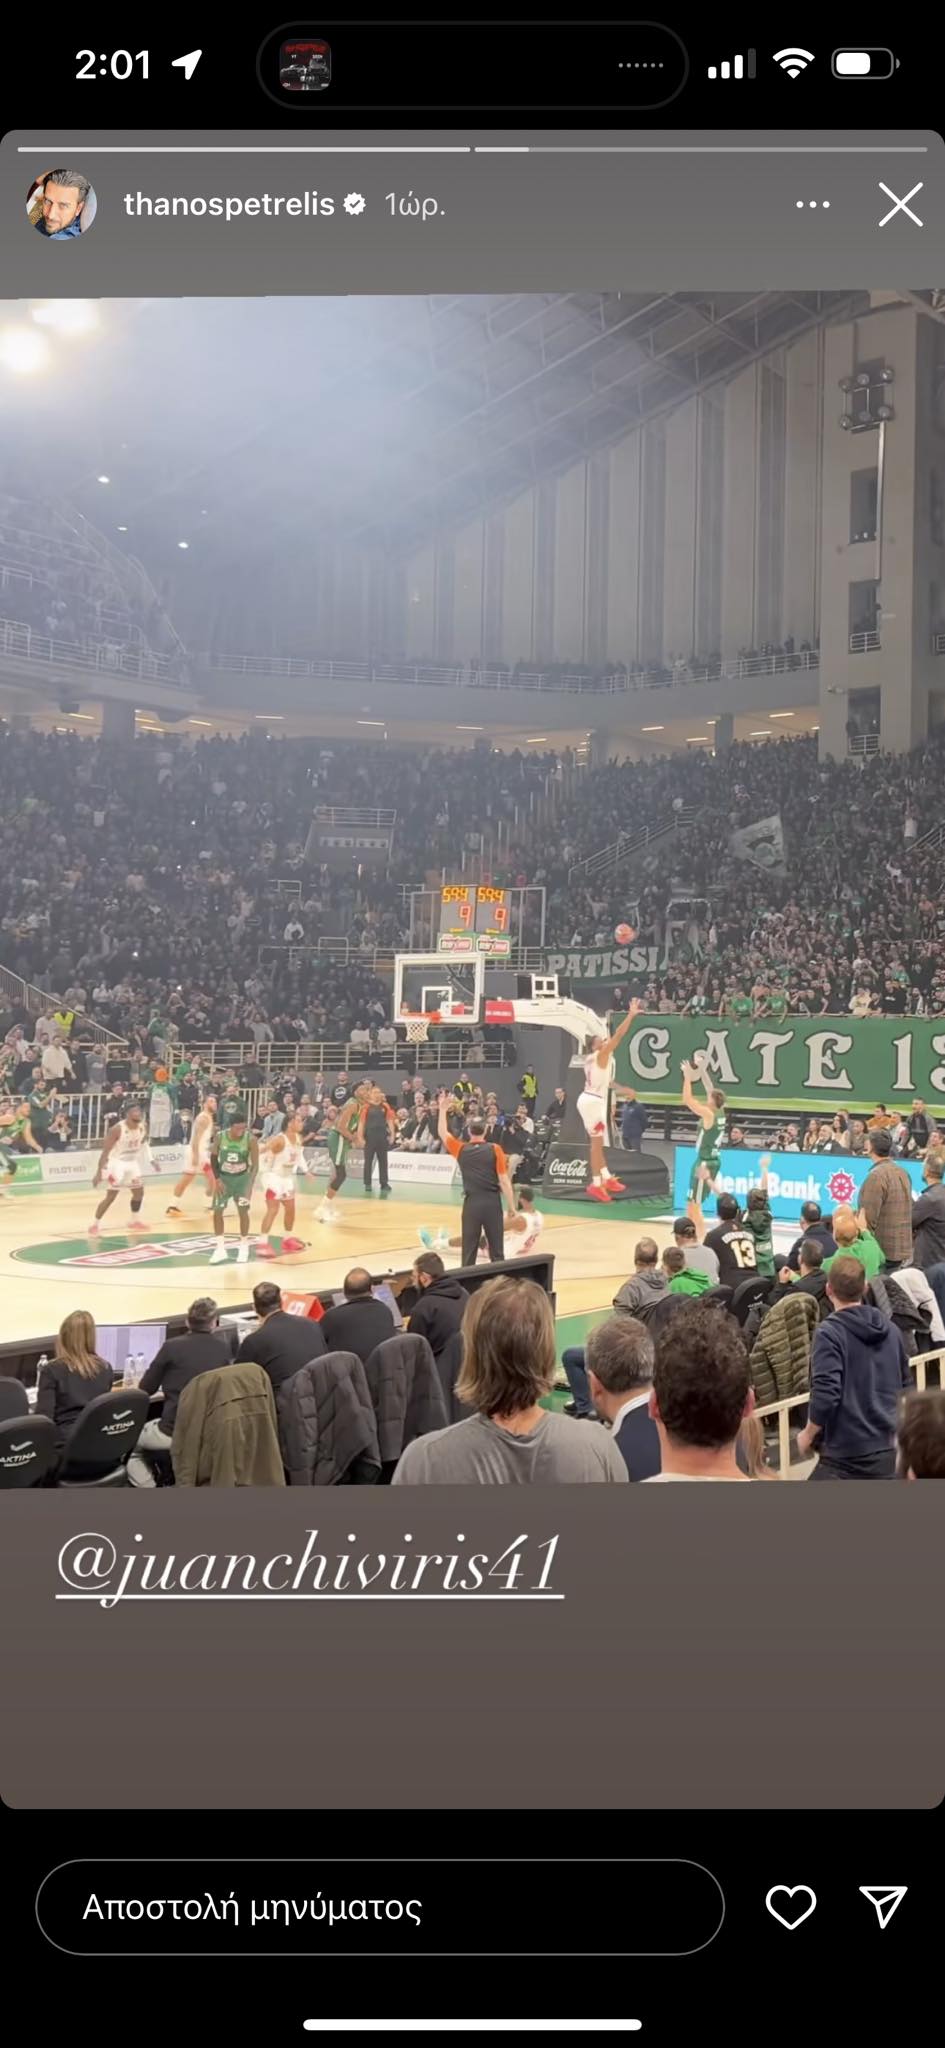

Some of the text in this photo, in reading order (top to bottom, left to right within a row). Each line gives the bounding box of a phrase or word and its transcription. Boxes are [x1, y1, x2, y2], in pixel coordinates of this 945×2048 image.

[460, 905, 471, 928] 9
[495, 908, 506, 931] 9
[629, 1027, 853, 1090] GATE
[731, 1240, 757, 1268] 13
